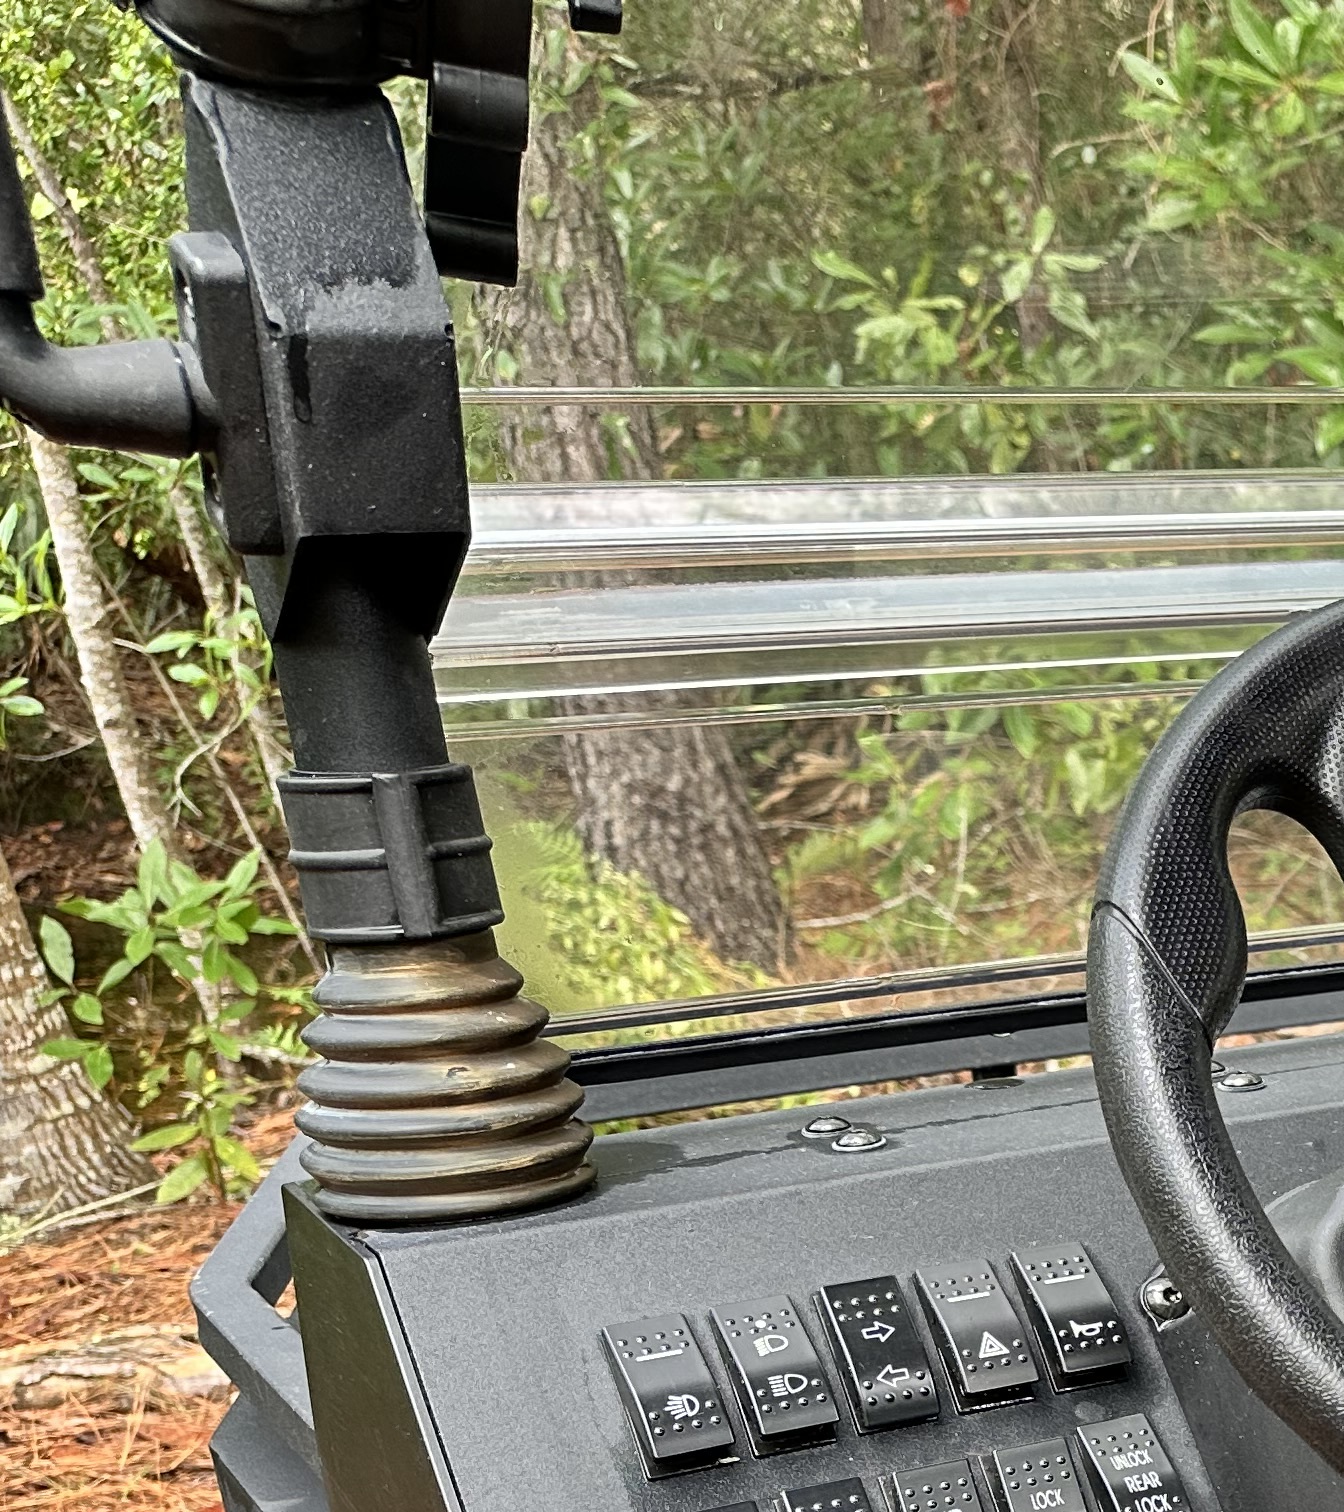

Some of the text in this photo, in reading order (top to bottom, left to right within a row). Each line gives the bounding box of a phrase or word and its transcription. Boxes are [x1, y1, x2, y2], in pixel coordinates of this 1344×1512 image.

[1109, 1449, 1153, 1472] UNLOCK
[1123, 1471, 1163, 1494] REAR
[1030, 1488, 1066, 1511] LOCK
